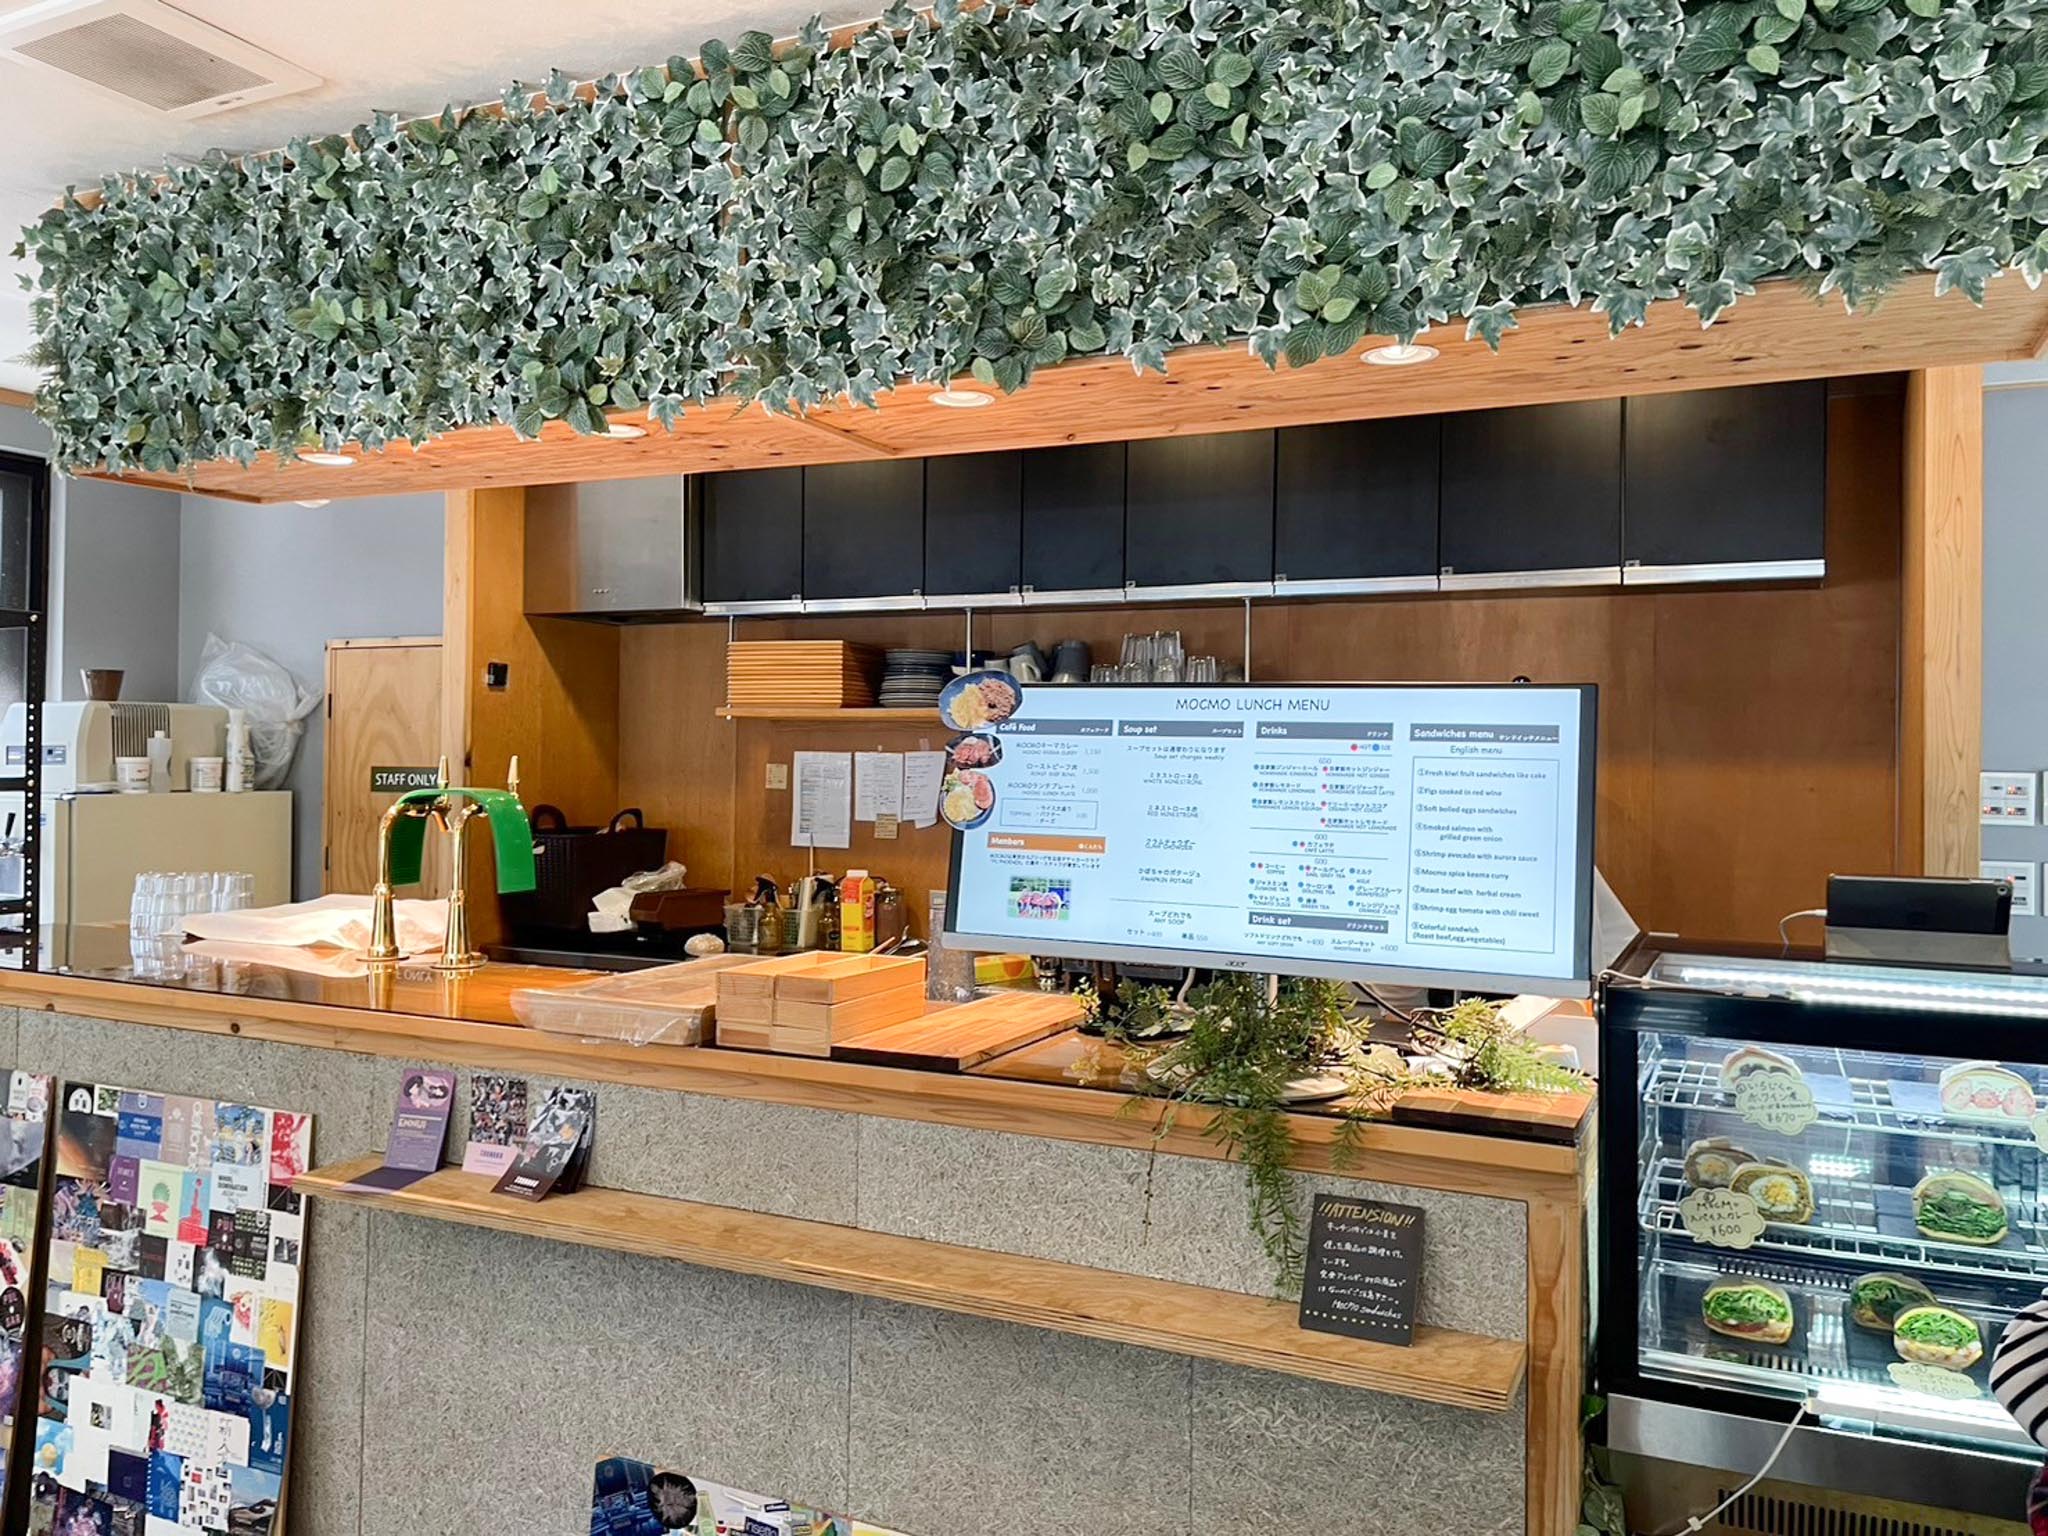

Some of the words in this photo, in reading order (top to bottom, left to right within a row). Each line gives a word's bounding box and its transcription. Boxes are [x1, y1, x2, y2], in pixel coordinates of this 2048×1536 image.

[1176, 698, 1230, 710] MOCMO
[1236, 699, 1282, 710] LUNCH
[1288, 699, 1330, 711] MENU
[1018, 724, 1036, 732] Food
[1123, 725, 1143, 735] Soup
[1145, 725, 1158, 733] set
[1261, 726, 1287, 735] Drinks
[1414, 729, 1466, 738] Sandwiches
[1450, 746, 1479, 756] English
[375, 773, 406, 785] STAFF
[408, 774, 437, 785] ONLY
[1252, 915, 1275, 923] Drink
